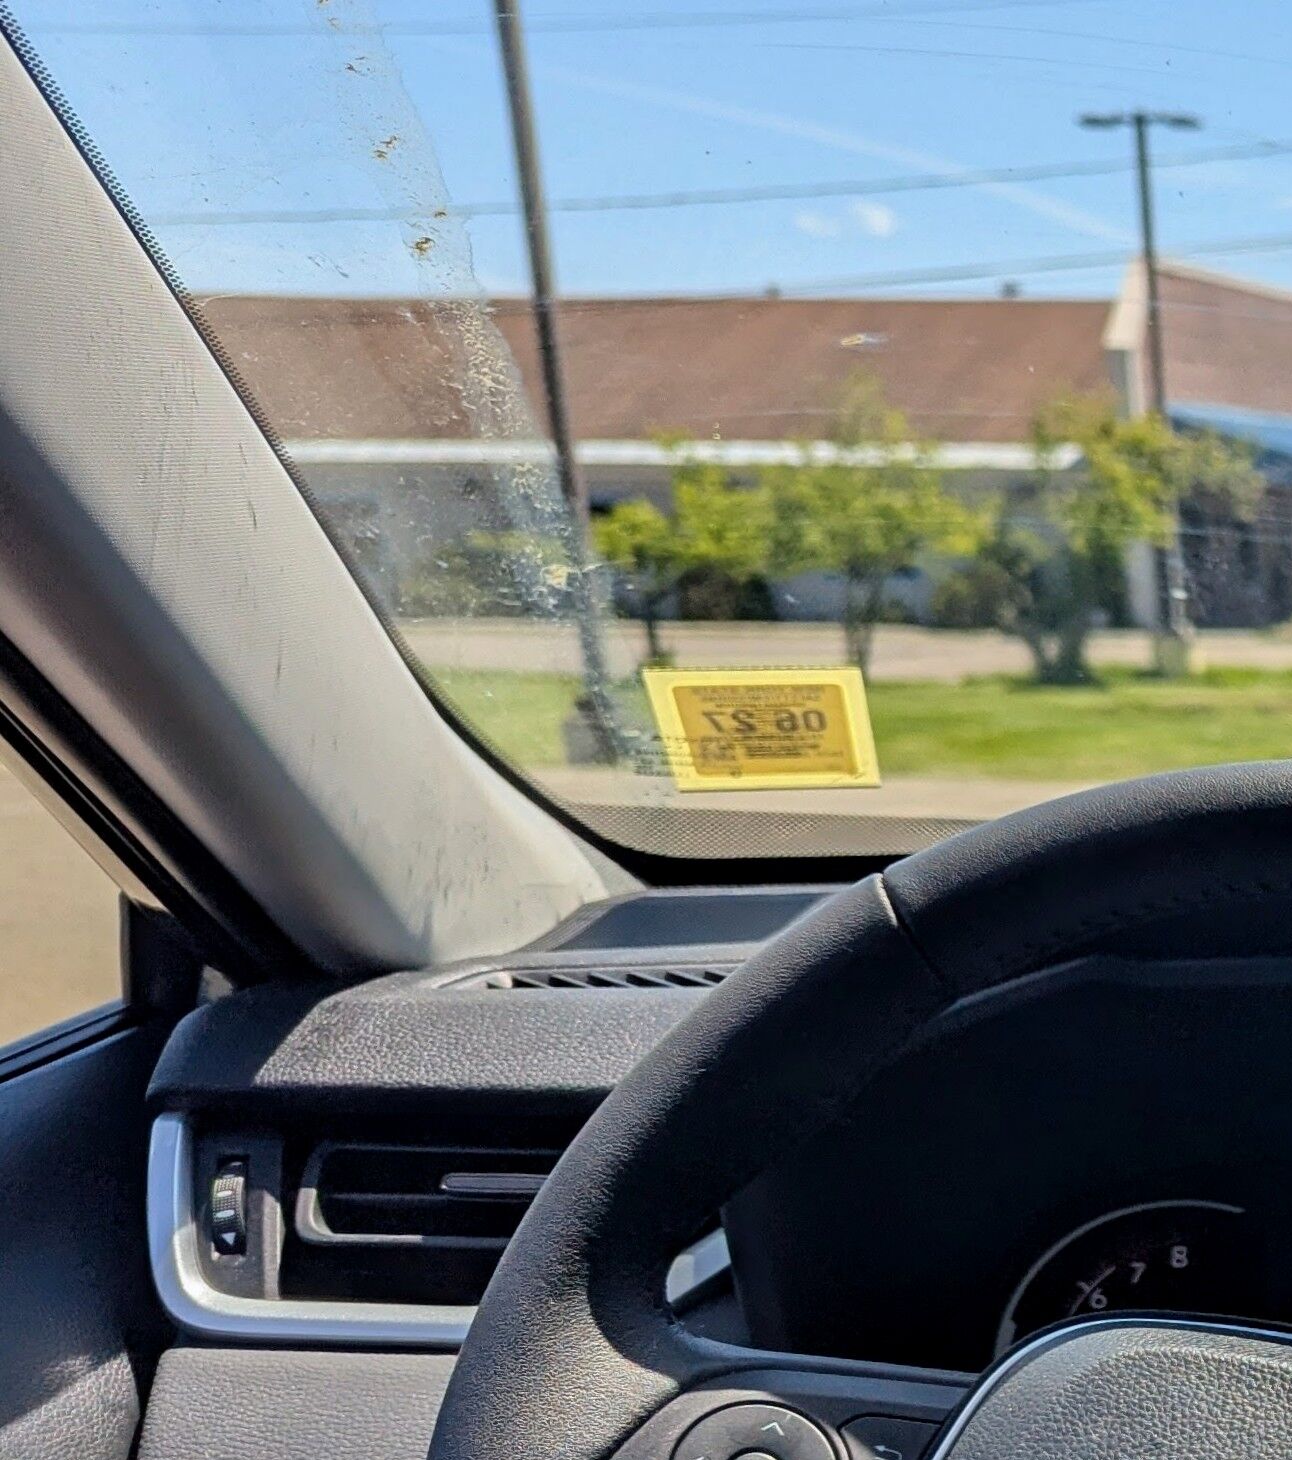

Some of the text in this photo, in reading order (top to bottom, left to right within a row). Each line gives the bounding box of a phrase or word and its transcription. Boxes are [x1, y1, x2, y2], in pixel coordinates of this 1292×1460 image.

[1170, 1245, 1189, 1269] 8
[1129, 1261, 1147, 1284] 7
[1090, 1287, 1108, 1309] 6
